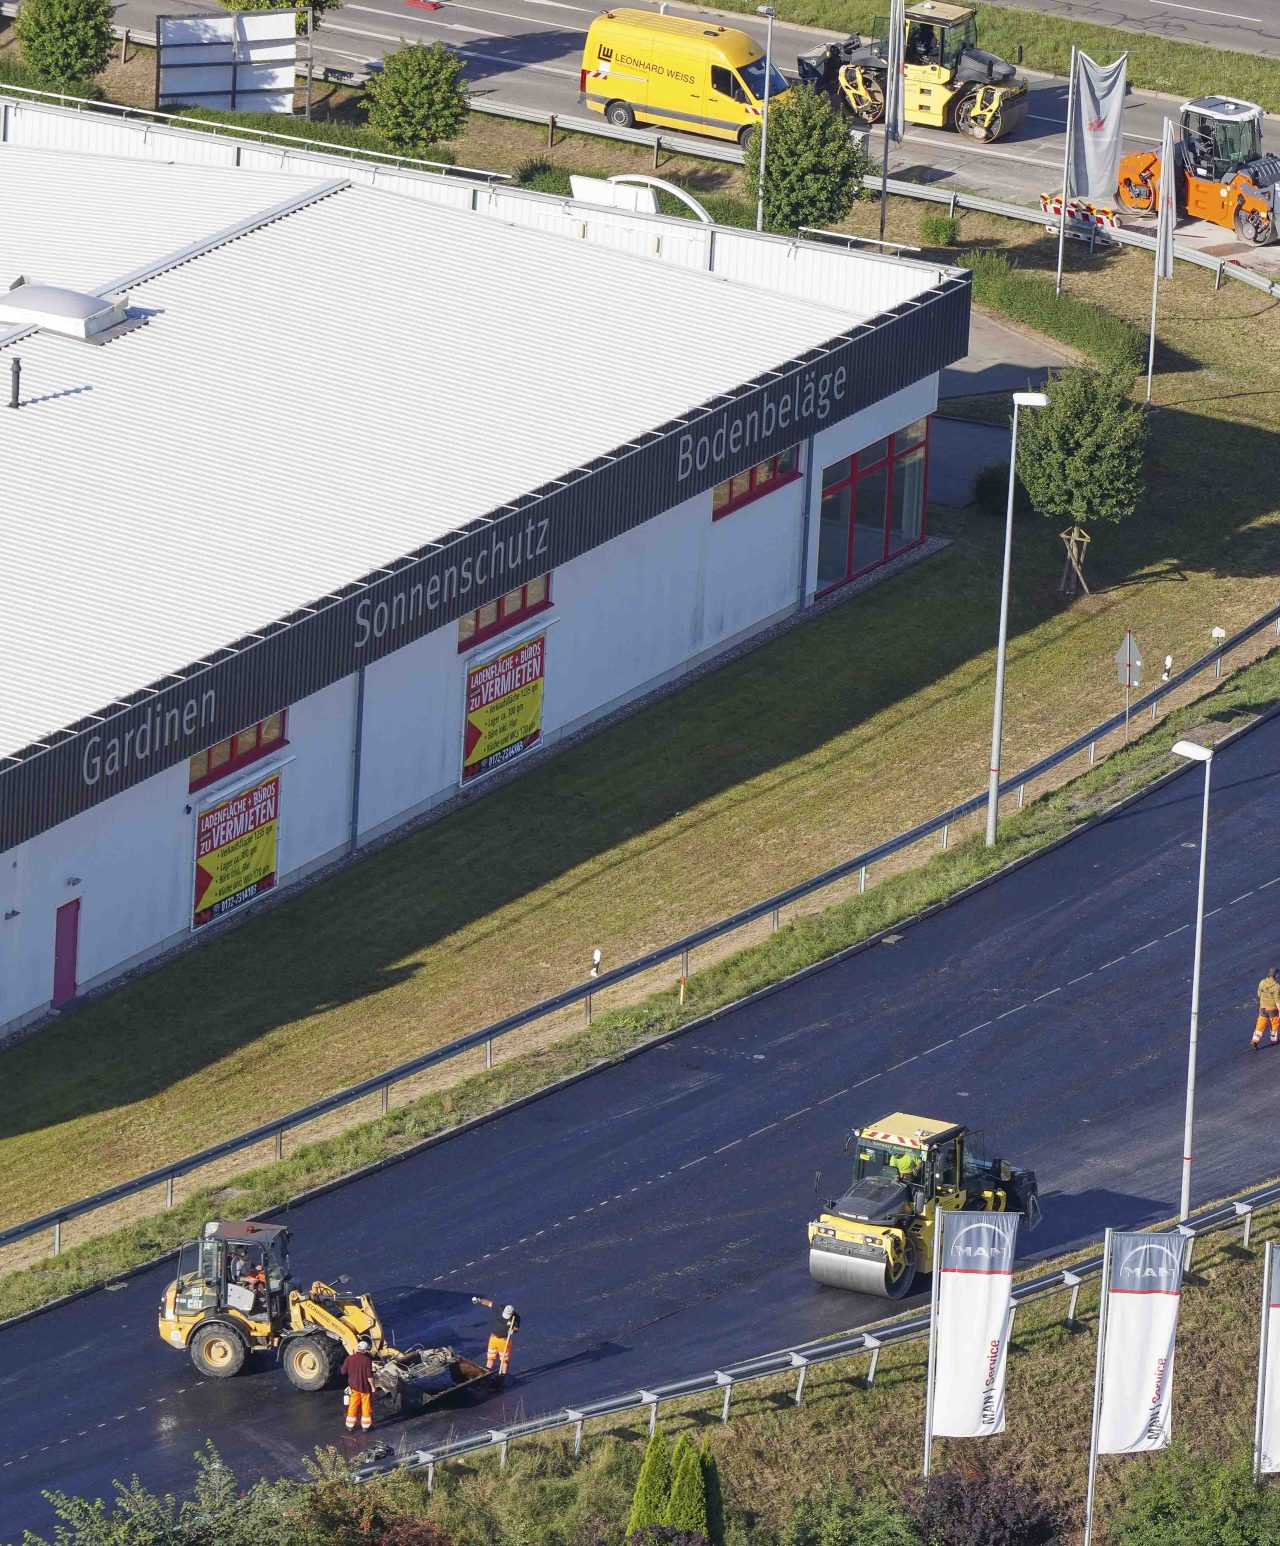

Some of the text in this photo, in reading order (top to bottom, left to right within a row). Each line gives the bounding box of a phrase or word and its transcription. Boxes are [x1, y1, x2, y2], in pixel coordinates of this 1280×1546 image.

[615, 53, 664, 75] LEONHARD
[667, 69, 695, 85] WEISS
[678, 366, 846, 481] Bodenbeläge
[354, 518, 549, 648] Sonnenschutz
[470, 656, 541, 711] ZU VERMIETEN
[471, 656, 513, 688] LADENFLÄCHE
[520, 642, 541, 663] BÜROS
[83, 690, 215, 785] Gardinen
[200, 796, 275, 855] ZU VERMIETEN
[201, 798, 247, 832] LADENFLÄCHE
[253, 782, 276, 806] BÜROS
[954, 1245, 1006, 1258] MAN
[1123, 1267, 1175, 1278] MAN
[982, 1340, 1000, 1425] MAN Service
[1151, 1358, 1167, 1403] Service
